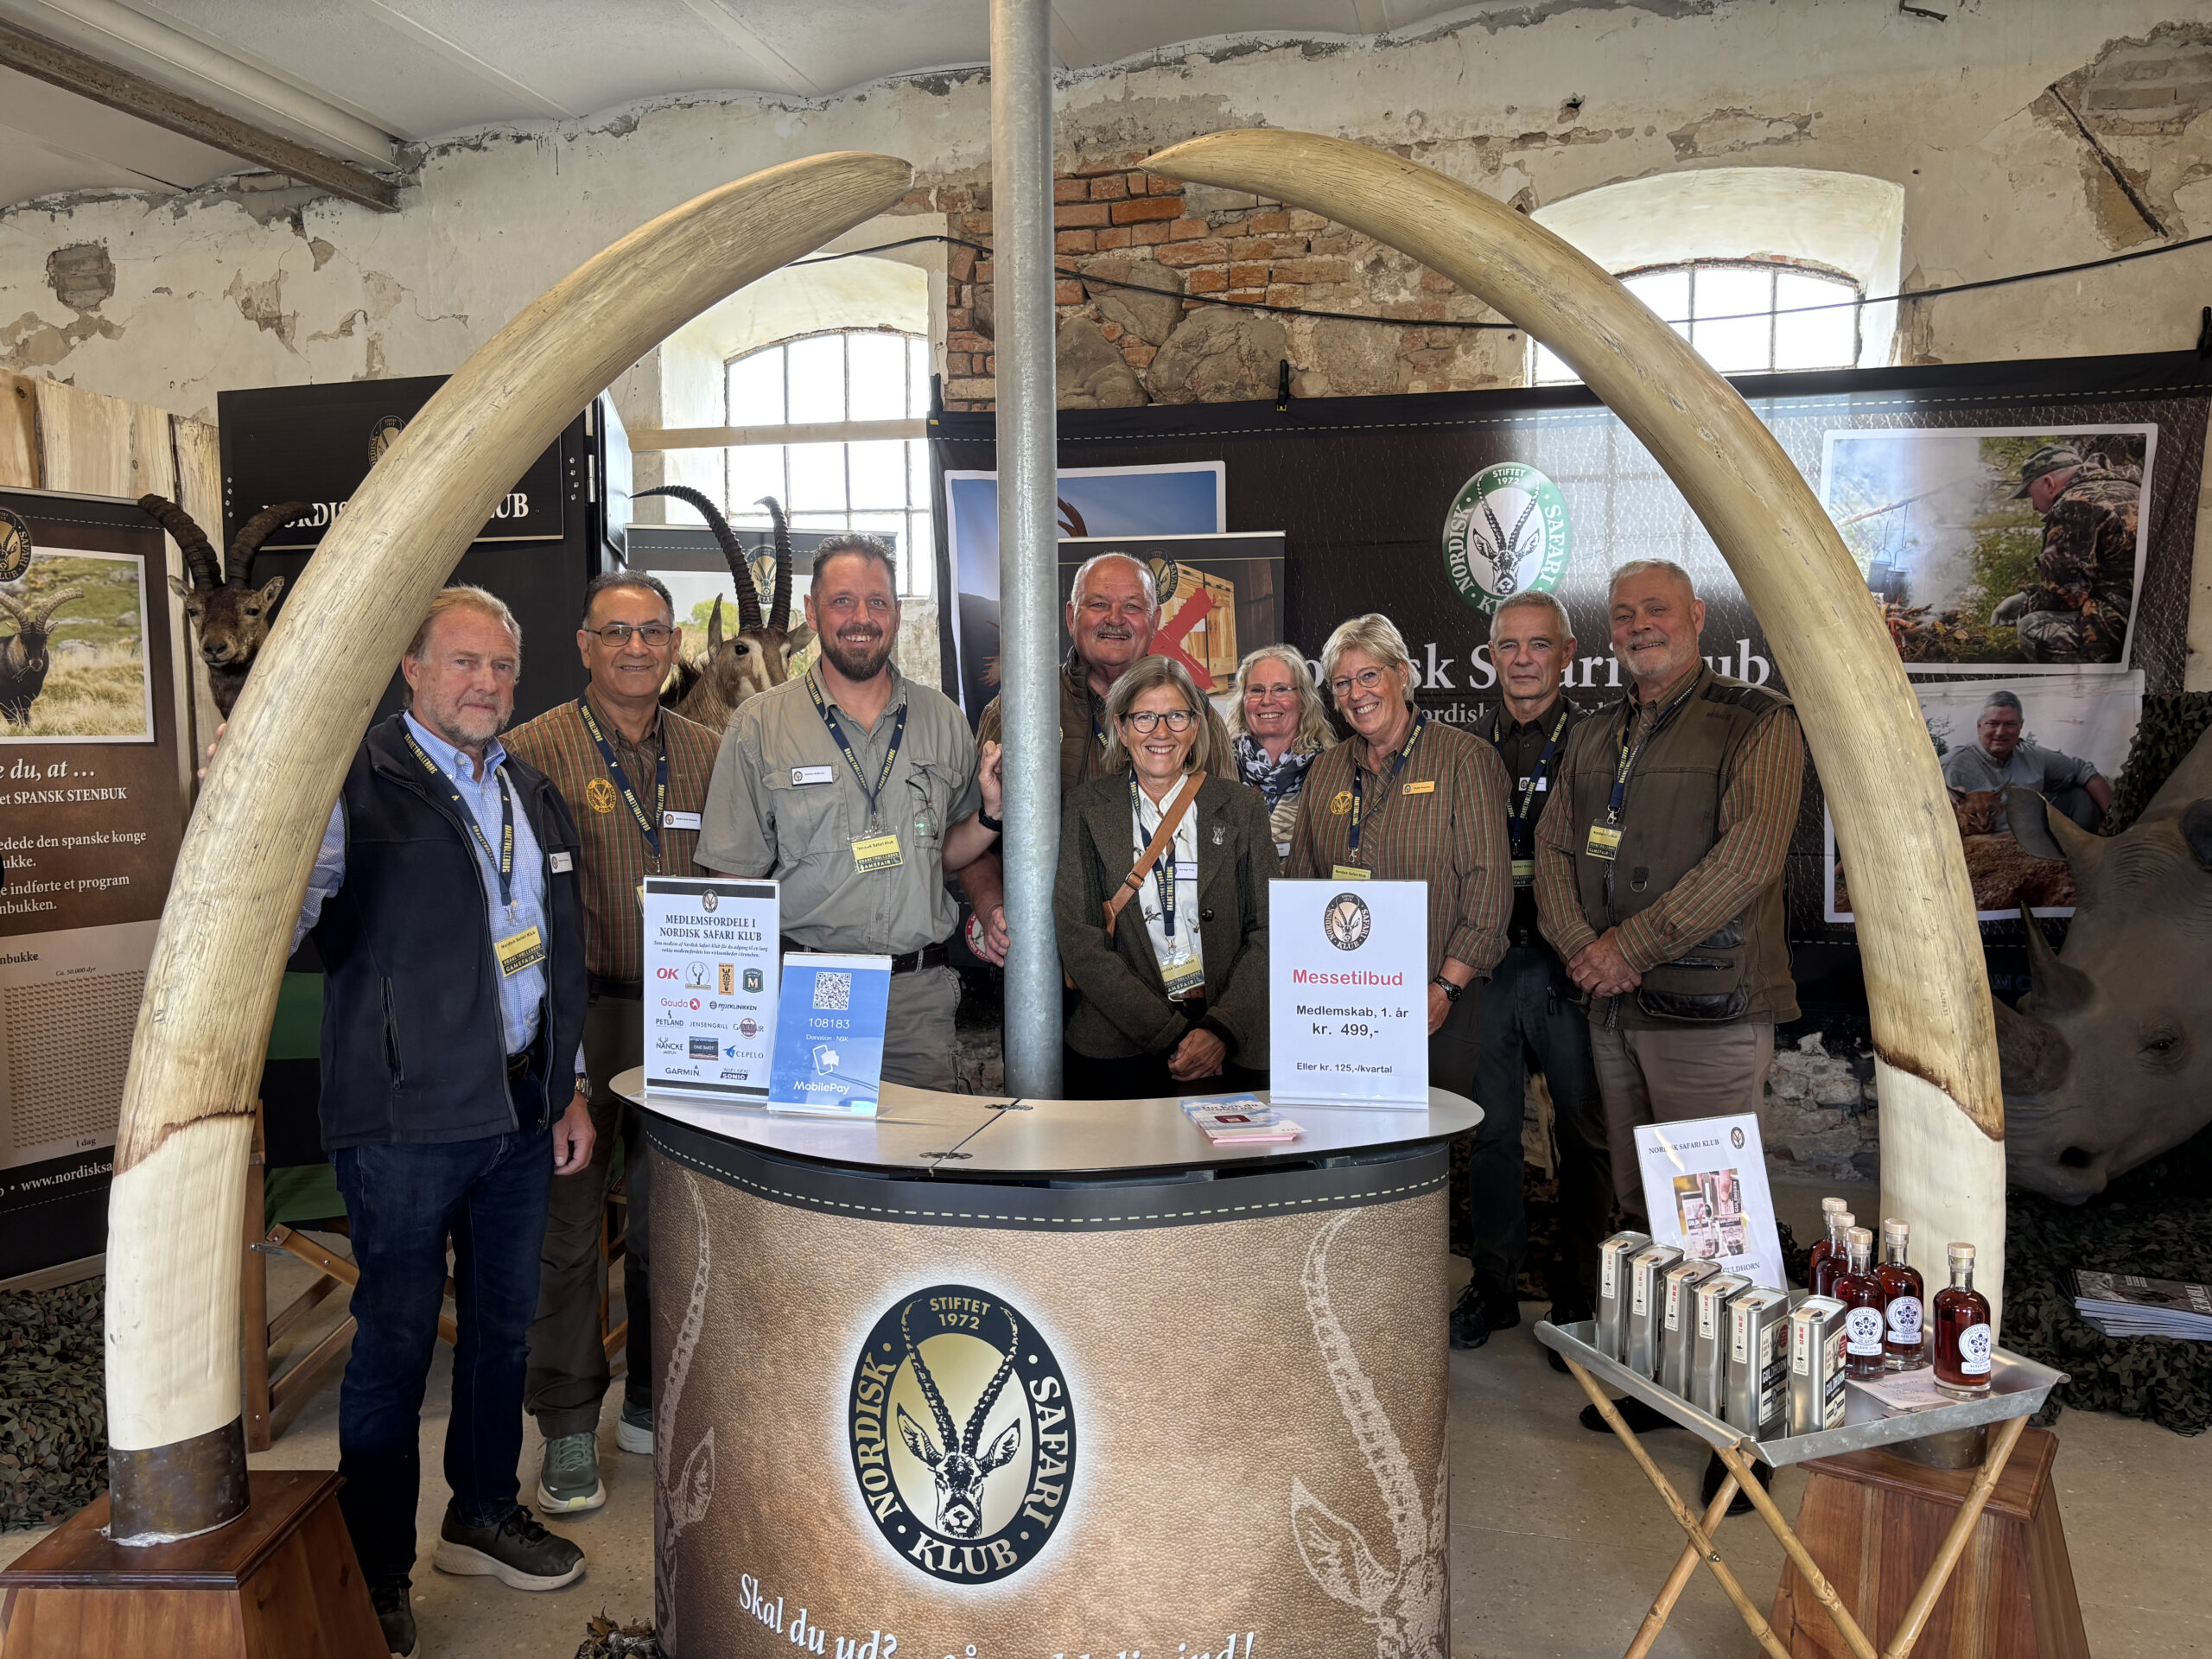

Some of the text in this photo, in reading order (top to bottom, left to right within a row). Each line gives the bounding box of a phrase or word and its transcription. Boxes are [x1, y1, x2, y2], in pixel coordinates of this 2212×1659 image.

[1492, 468, 1526, 478] STIFTET
[1497, 477, 1520, 486] 1972
[19, 531, 30, 568] SAFARI
[1448, 504, 1475, 594] NORDISK
[1539, 504, 1566, 585] SAFARI
[10, 758, 42, 782] du,
[47, 760, 69, 779] at
[14, 790, 65, 804] SPANSK
[67, 787, 129, 802] STENBUK
[36, 835, 59, 849] den
[61, 831, 110, 850] spanske
[111, 830, 147, 845] konge
[10, 875, 130, 895] indførte et program
[665, 914, 756, 928] MEDLEMSFORDELE I
[1325, 907, 1335, 941] NORDISK
[1361, 908, 1370, 940] SAFARI
[659, 927, 762, 942] NORDISK SAFARI KLUB
[1336, 940, 1360, 950] KLUB
[86, 965, 98, 974] dyr
[505, 954, 535, 972] GAMEFAIR
[657, 967, 680, 980] OK
[1293, 969, 1403, 987] Messetilbud
[747, 977, 759, 988] M
[1167, 978, 1194, 993] AMEFAIR
[661, 997, 689, 1008] Gouda
[1296, 1004, 1409, 1019] Medlemskab, 1. år
[656, 1018, 684, 1027] PETLAND
[690, 1020, 728, 1030] JENSENGRILL
[808, 1017, 851, 1030] 108183
[805, 1033, 833, 1042] Donation
[1313, 1022, 1380, 1039] kr. 499,-
[656, 1042, 684, 1052] NANCKE
[735, 1051, 765, 1059] CEPELO
[664, 1067, 700, 1077] GARMIN
[1296, 1062, 1393, 1074] Eller kr. 125,-/kvartal
[792, 1080, 850, 1096] MobilePay
[81, 1137, 97, 1147] dag
[1679, 1141, 1701, 1150] SAFARI
[1702, 1138, 1719, 1147] KLUB
[930, 1296, 992, 1317] STIFTET
[938, 1313, 981, 1331] 1972
[855, 1351, 904, 1524] NORDISK
[1023, 1376, 1070, 1529] SAFARI
[908, 1530, 1019, 1576] KLUB
[740, 1573, 784, 1635] Skal
[790, 1608, 826, 1656] du
